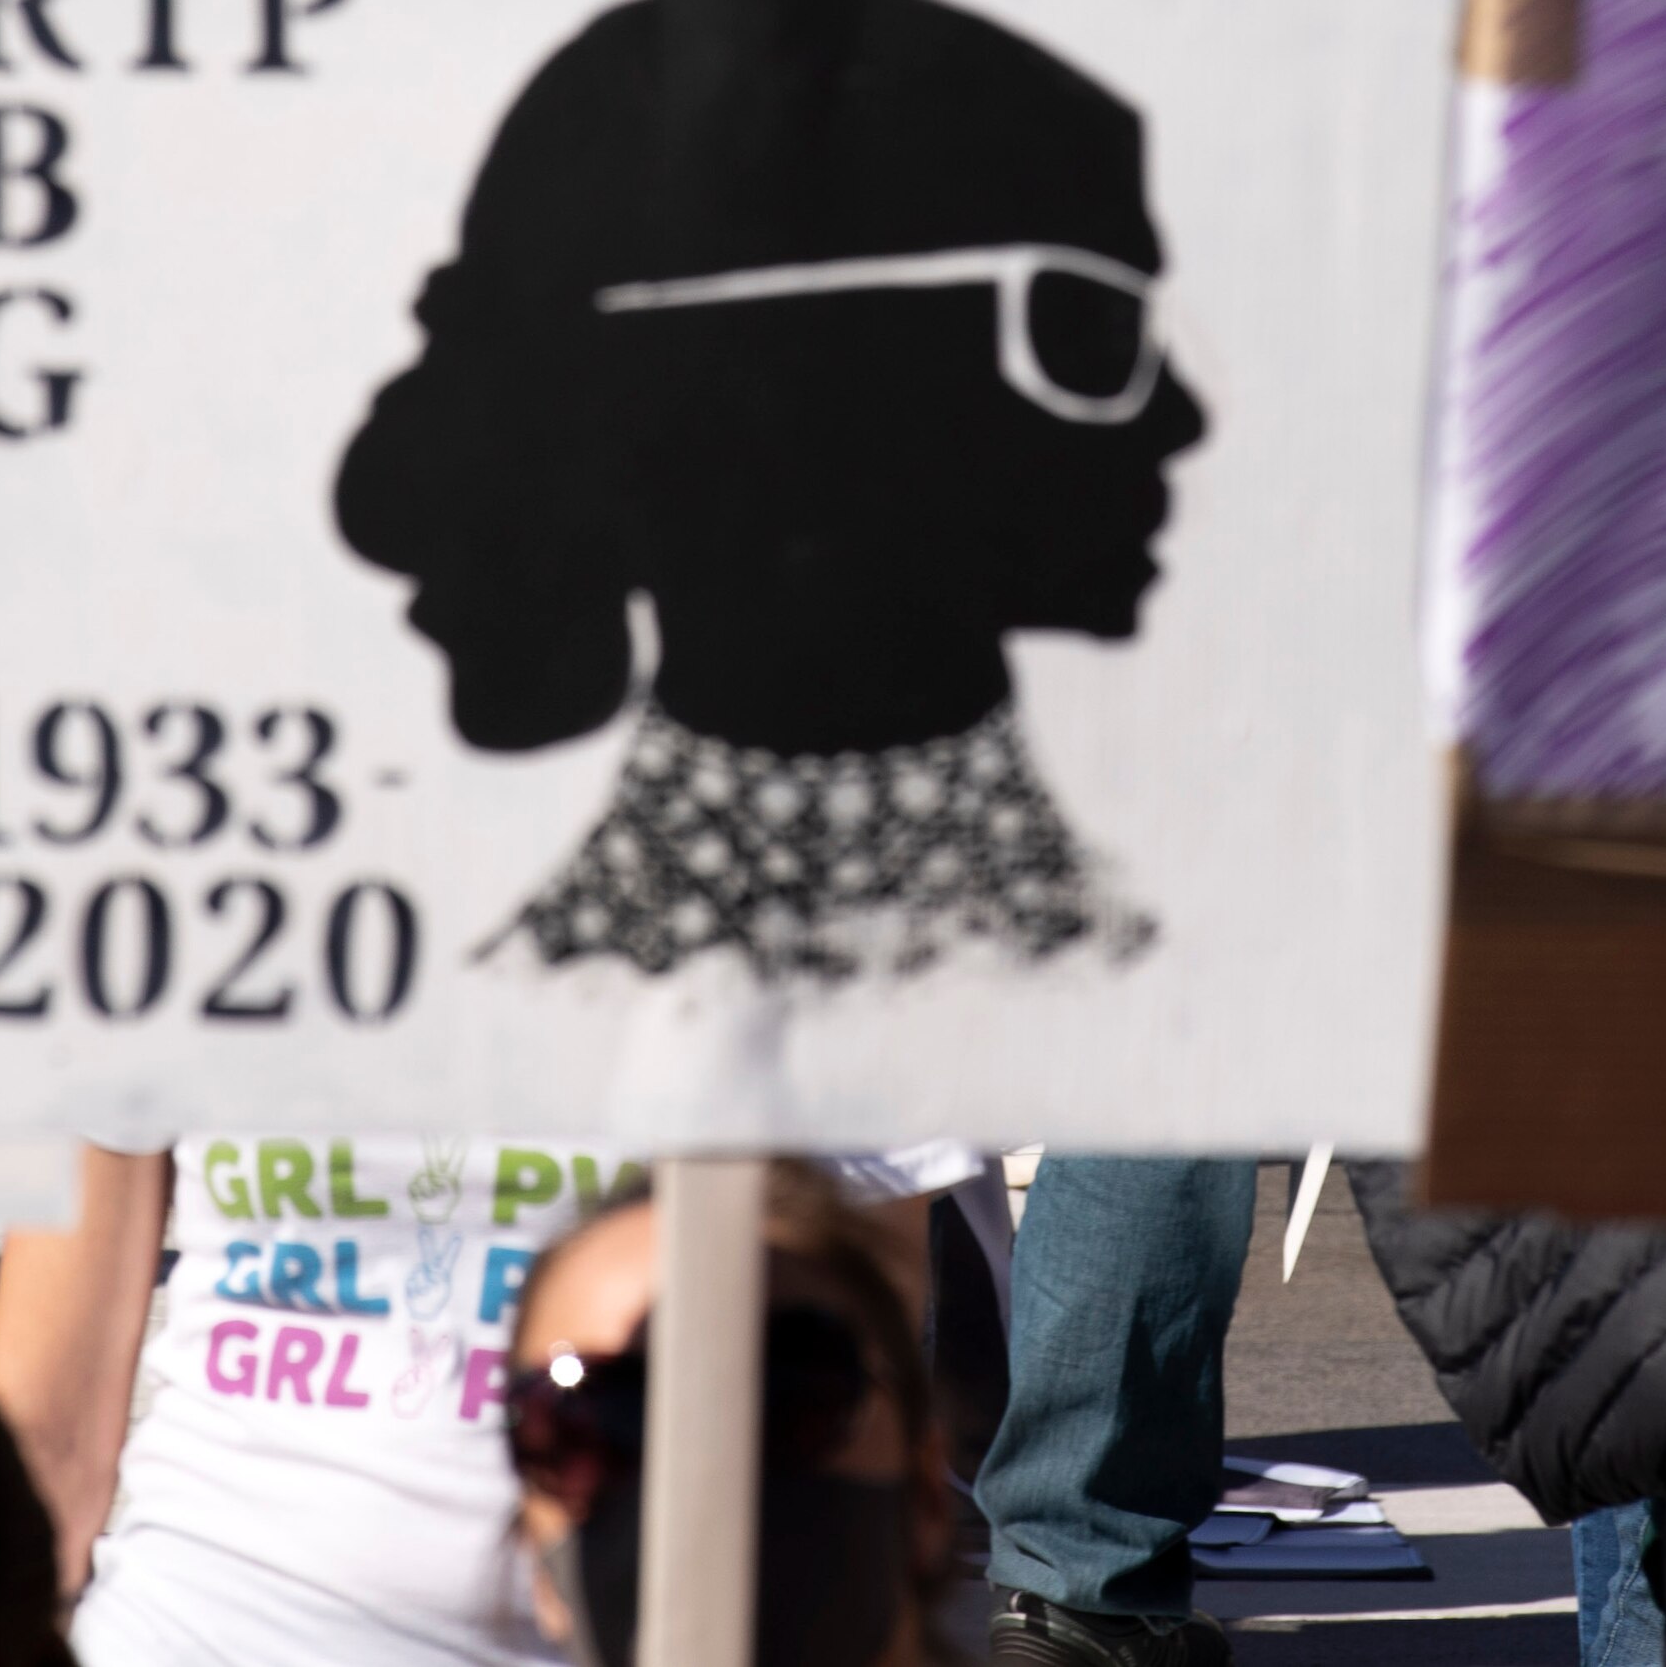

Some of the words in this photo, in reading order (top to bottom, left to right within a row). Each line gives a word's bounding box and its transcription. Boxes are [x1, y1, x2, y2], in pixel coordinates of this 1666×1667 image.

[204, 1136, 390, 1221] GRL
[492, 1146, 645, 1226] PW
[214, 1240, 391, 1316] GRL
[204, 1319, 370, 1409] GRL
